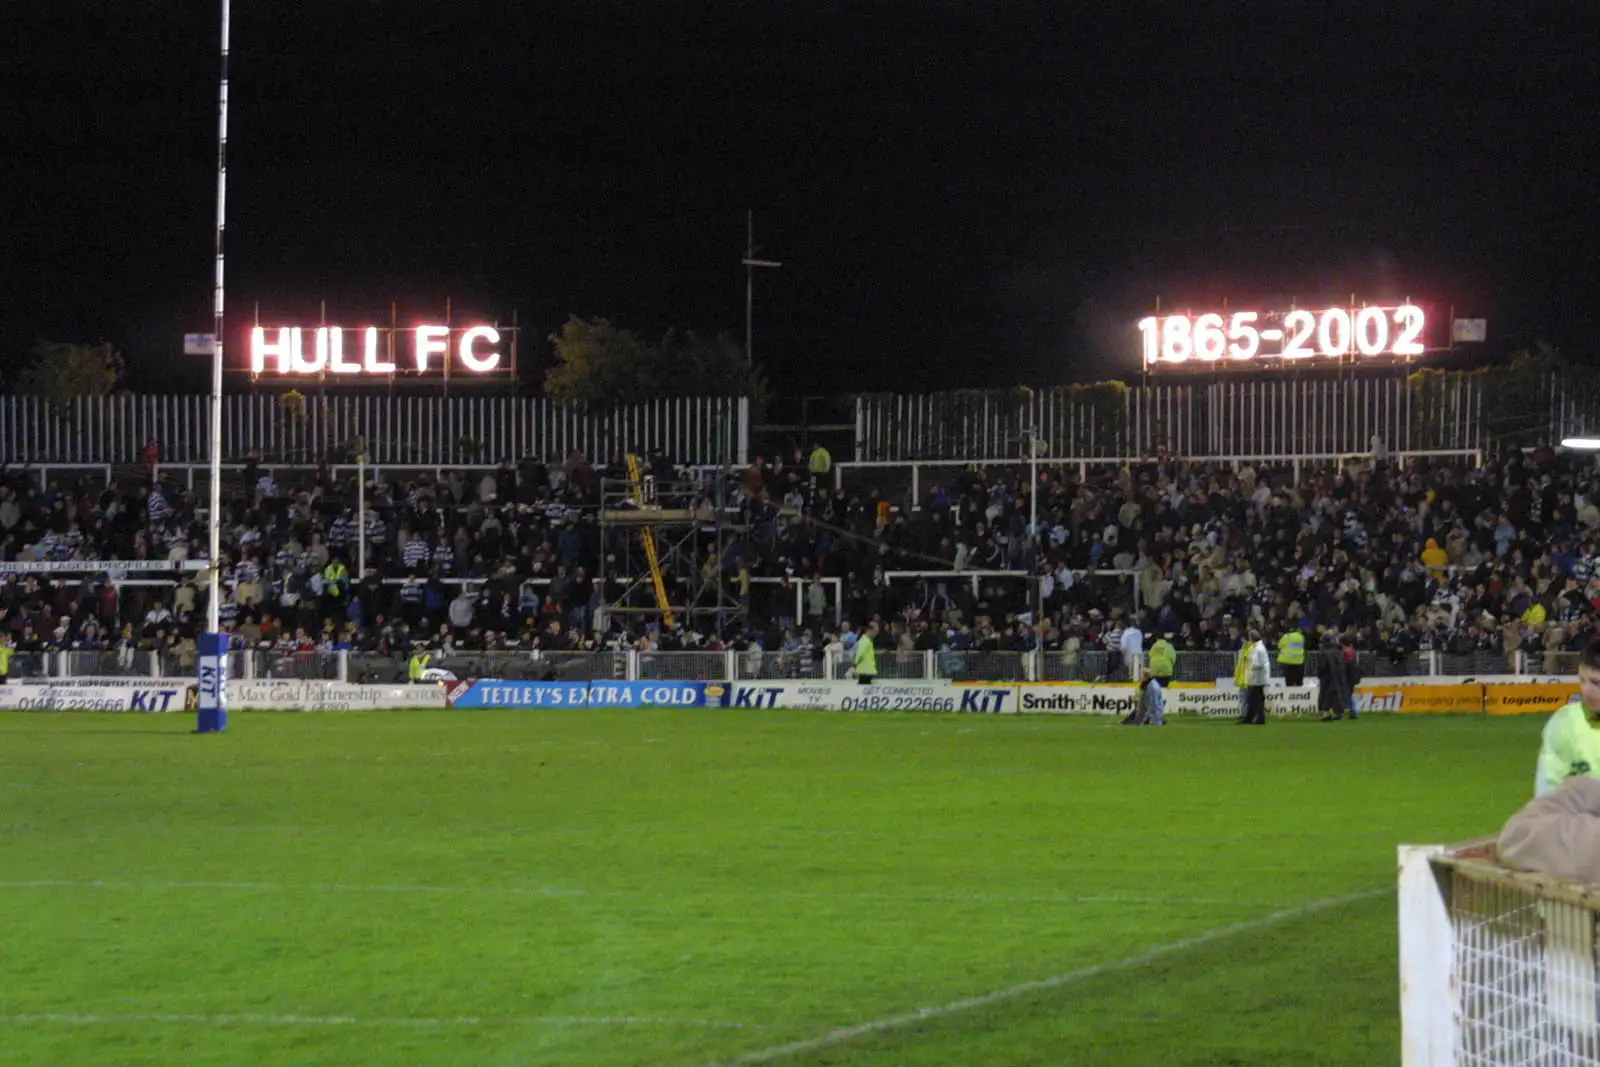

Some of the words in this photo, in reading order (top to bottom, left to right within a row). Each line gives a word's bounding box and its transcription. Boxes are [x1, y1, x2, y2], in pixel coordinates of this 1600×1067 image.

[1138, 304, 1425, 364] 1865-2002
[251, 326, 396, 373] HULL
[304, 682, 382, 703] Partnership
[480, 687, 563, 704] TETLEY'S
[568, 687, 633, 704] EXTRA
[640, 687, 697, 704] COLD
[1178, 691, 1240, 703] Supportin
[1288, 690, 1311, 701] and
[1502, 695, 1560, 706] together
[841, 696, 889, 712] 01482
[894, 697, 954, 713] 222666
[1291, 704, 1317, 714] Hull
